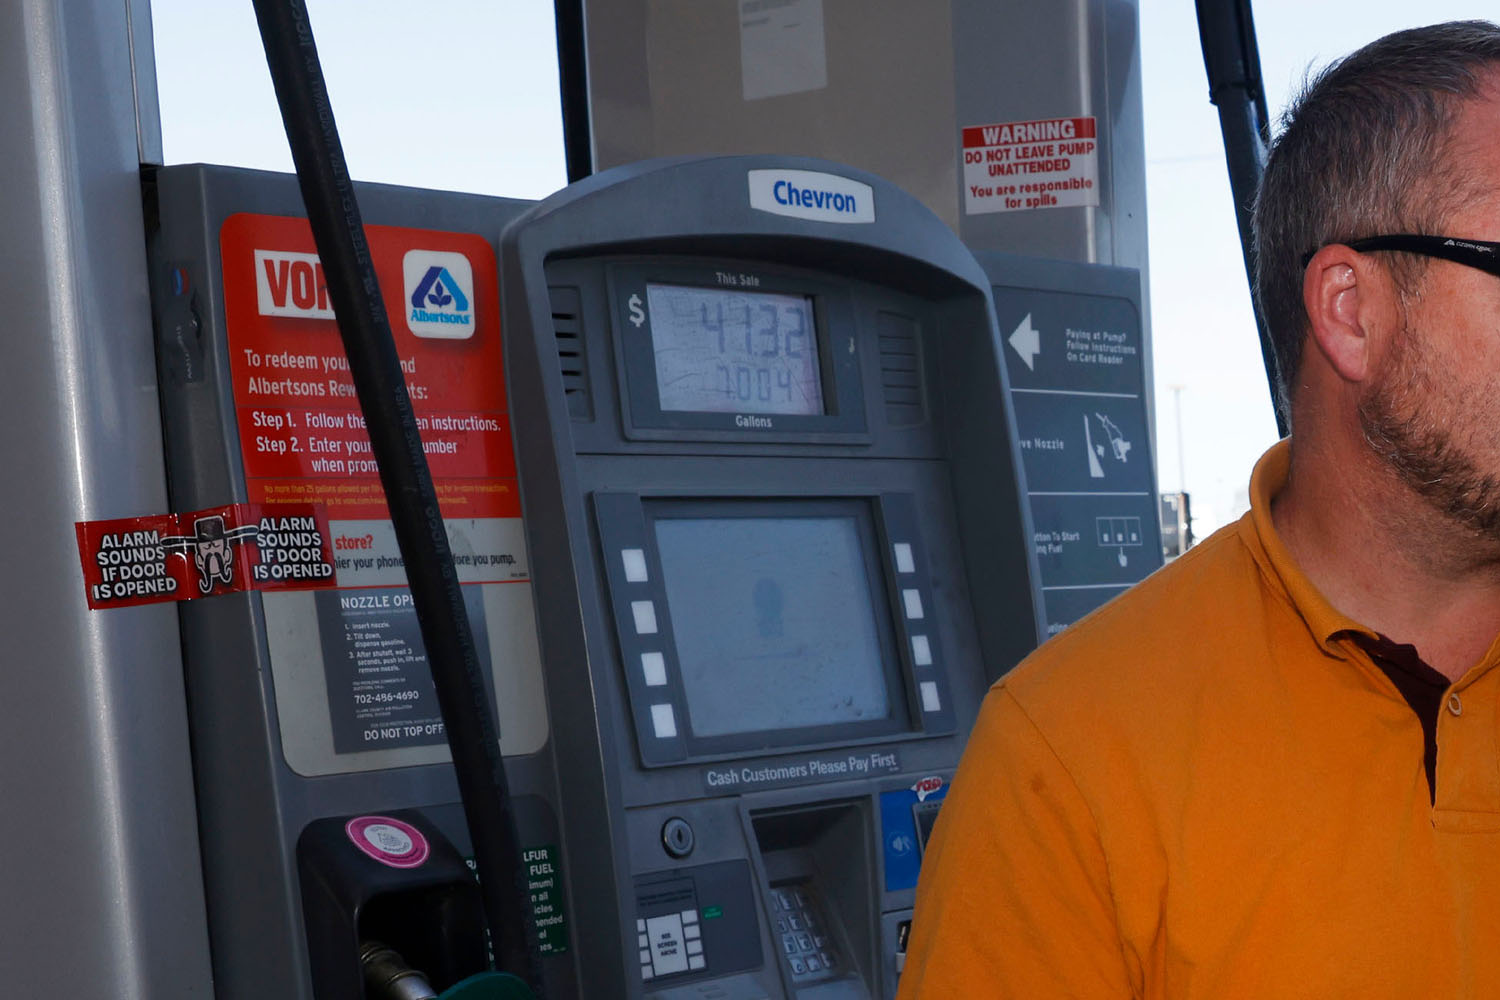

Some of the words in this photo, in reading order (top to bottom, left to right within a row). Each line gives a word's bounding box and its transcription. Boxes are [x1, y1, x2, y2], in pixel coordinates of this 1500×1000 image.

[982, 120, 1076, 146] WARNING
[965, 152, 983, 164] DO
[986, 149, 1011, 163] NOT
[1015, 145, 1055, 160] LEAVE
[1058, 142, 1095, 156] PUMP
[988, 158, 1071, 177] UNATTENDED
[970, 186, 993, 198] You
[996, 186, 1016, 195] are
[1019, 177, 1093, 195] responsible
[773, 180, 857, 214] Chevron
[1005, 198, 1023, 209] for
[1026, 195, 1058, 209] spills
[716, 272, 737, 284] This
[739, 274, 760, 287] Sale
[410, 307, 470, 325] Albertsons
[628, 294, 645, 327] $
[245, 349, 261, 367] To
[265, 352, 318, 370] redeem
[1067, 352, 1077, 361] On
[1079, 353, 1096, 362] Card
[248, 378, 325, 396] Albertsons
[329, 379, 356, 397] Rew
[253, 411, 283, 430] Step
[286, 413, 297, 428] 1.
[305, 412, 344, 429] Follow
[431, 415, 501, 432] instructions.
[735, 415, 773, 428] Gallons
[256, 436, 286, 454] Step
[290, 437, 304, 453] 2.
[309, 437, 342, 454] Enter
[423, 440, 458, 455] umber
[1034, 438, 1064, 449] Nozzle
[311, 459, 345, 473] when
[348, 459, 378, 476] prom
[260, 517, 315, 531] ALARM
[102, 529, 159, 549] ALARM
[257, 532, 322, 547] SOUNDS
[335, 534, 373, 550] store?
[97, 546, 166, 566] SOUNDS
[261, 549, 274, 563] IF
[276, 548, 322, 563] DOOR
[353, 555, 373, 571] your
[473, 554, 488, 569] you
[490, 553, 516, 567] pump.
[102, 568, 117, 583] IF
[118, 562, 166, 581] DOOR
[254, 565, 269, 579] IS
[271, 563, 333, 578] OPENED
[93, 583, 112, 599] IS
[114, 577, 178, 597] OPENED
[341, 596, 390, 609] NOZZLE
[364, 730, 379, 740] DO
[381, 728, 401, 739] NOT
[404, 726, 423, 737] TOP
[425, 723, 444, 735] OFF
[707, 770, 739, 786] Cash
[742, 762, 807, 782] Customers
[809, 760, 846, 776] Please
[848, 755, 869, 772] Pay
[871, 753, 896, 769] First
[523, 849, 549, 861] LFUR
[530, 863, 554, 875] FUEL
[539, 891, 549, 900] all
